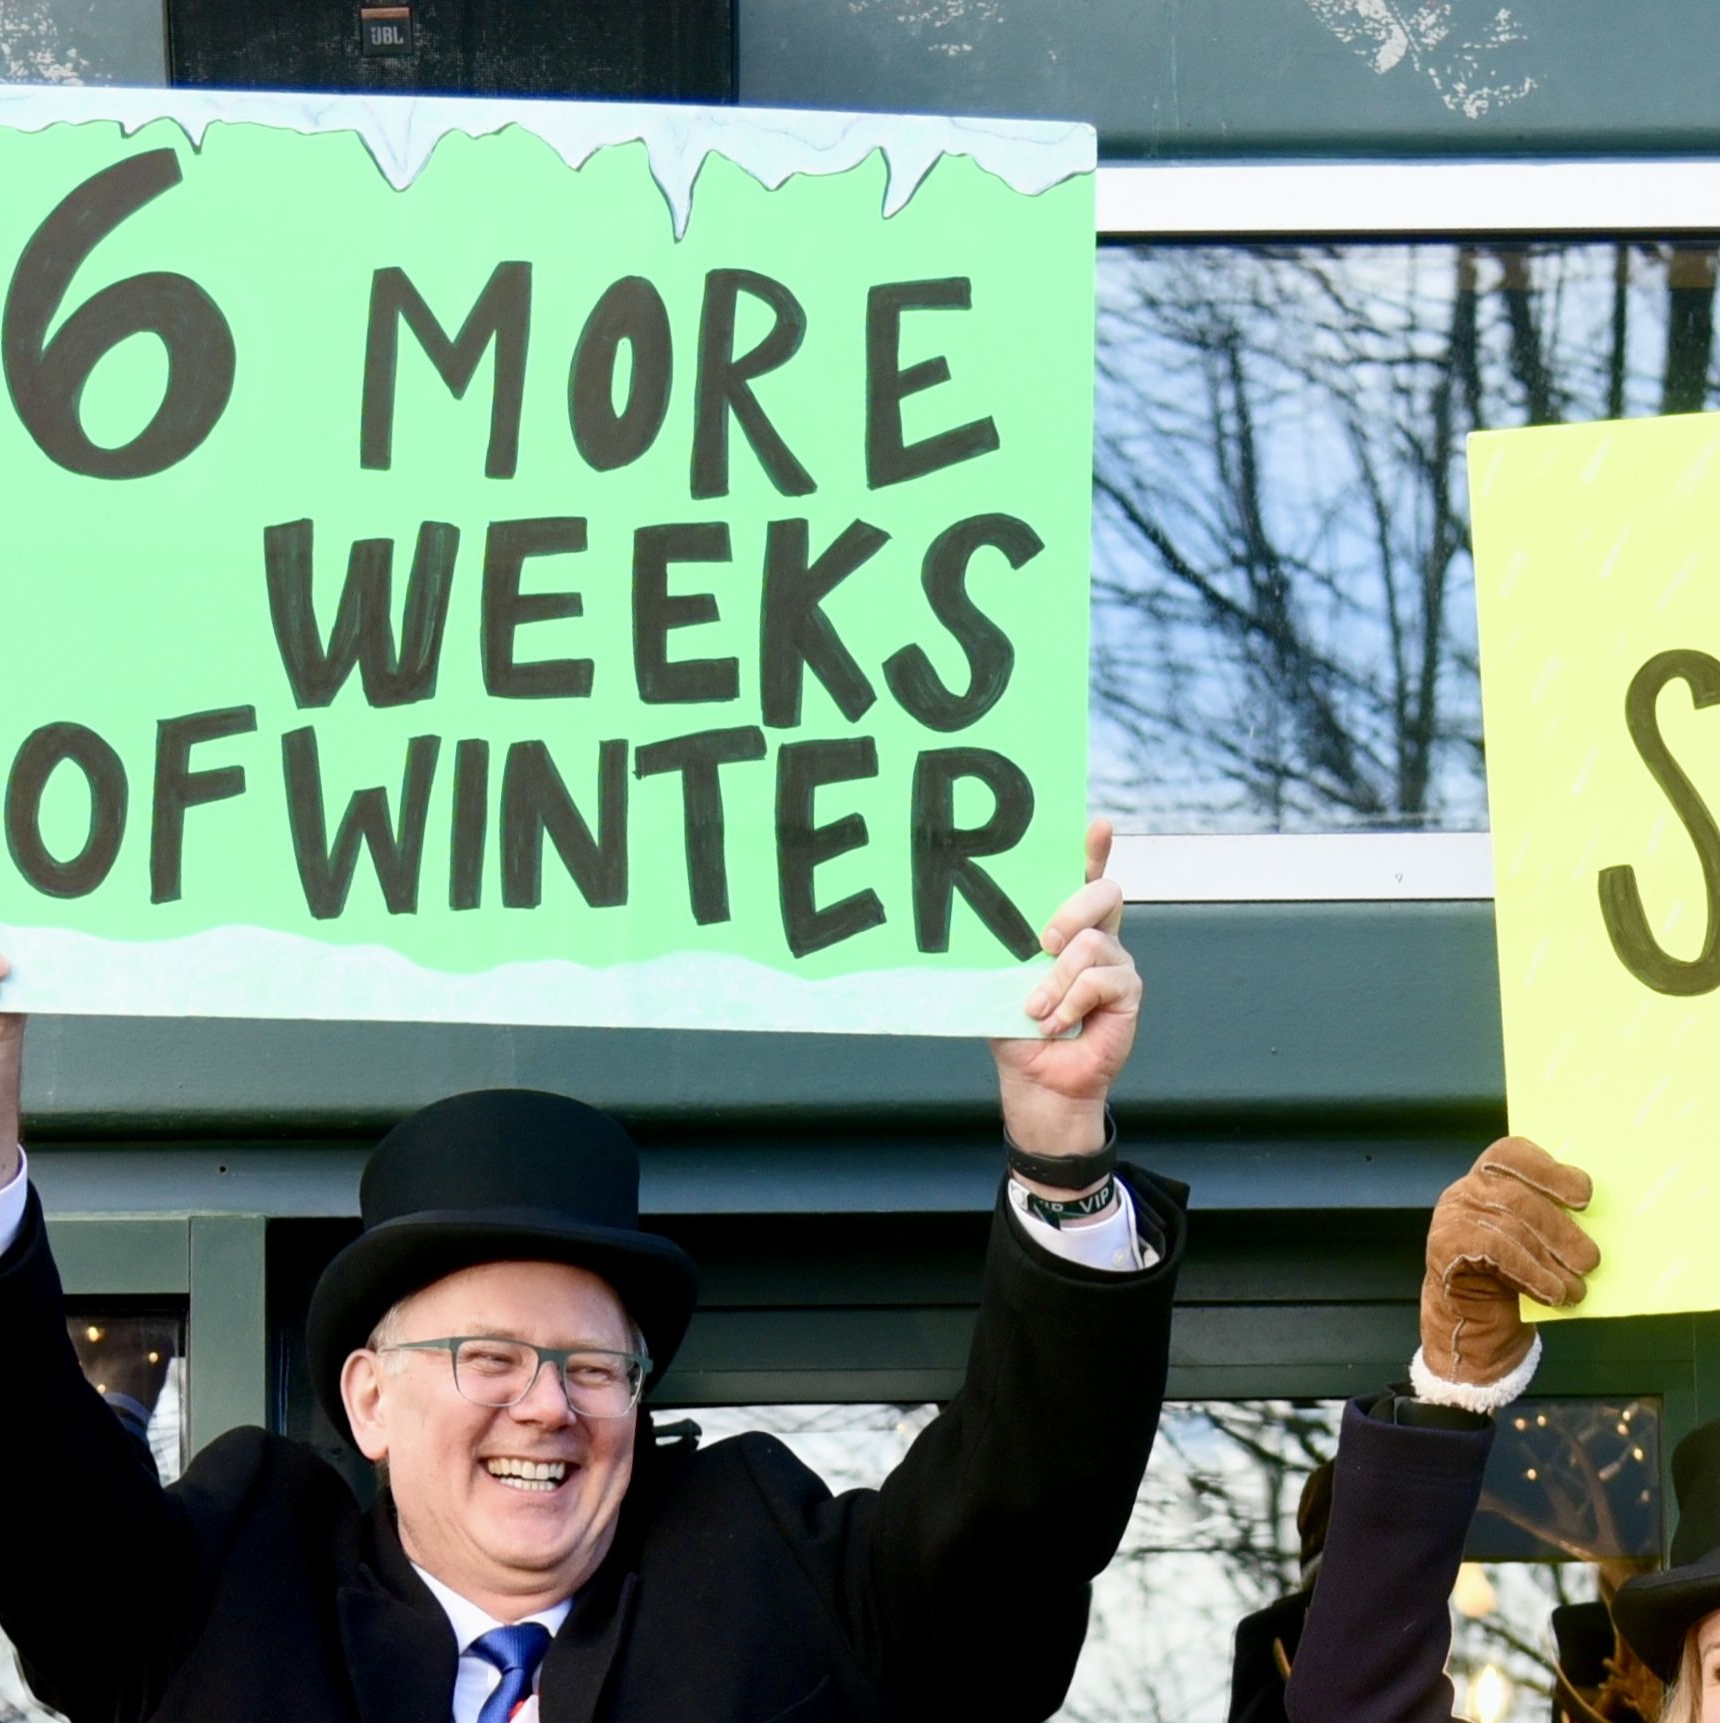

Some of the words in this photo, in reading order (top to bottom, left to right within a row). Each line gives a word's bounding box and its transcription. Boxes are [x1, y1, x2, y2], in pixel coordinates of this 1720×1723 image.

[370, 26, 404, 45] JBL
[1, 147, 237, 481] 6
[359, 260, 1001, 500] MORE
[263, 512, 1045, 733] WEEKS
[3, 704, 258, 904] OF
[280, 724, 1043, 962] WINTER
[1078, 1186, 1110, 1214] VIP
